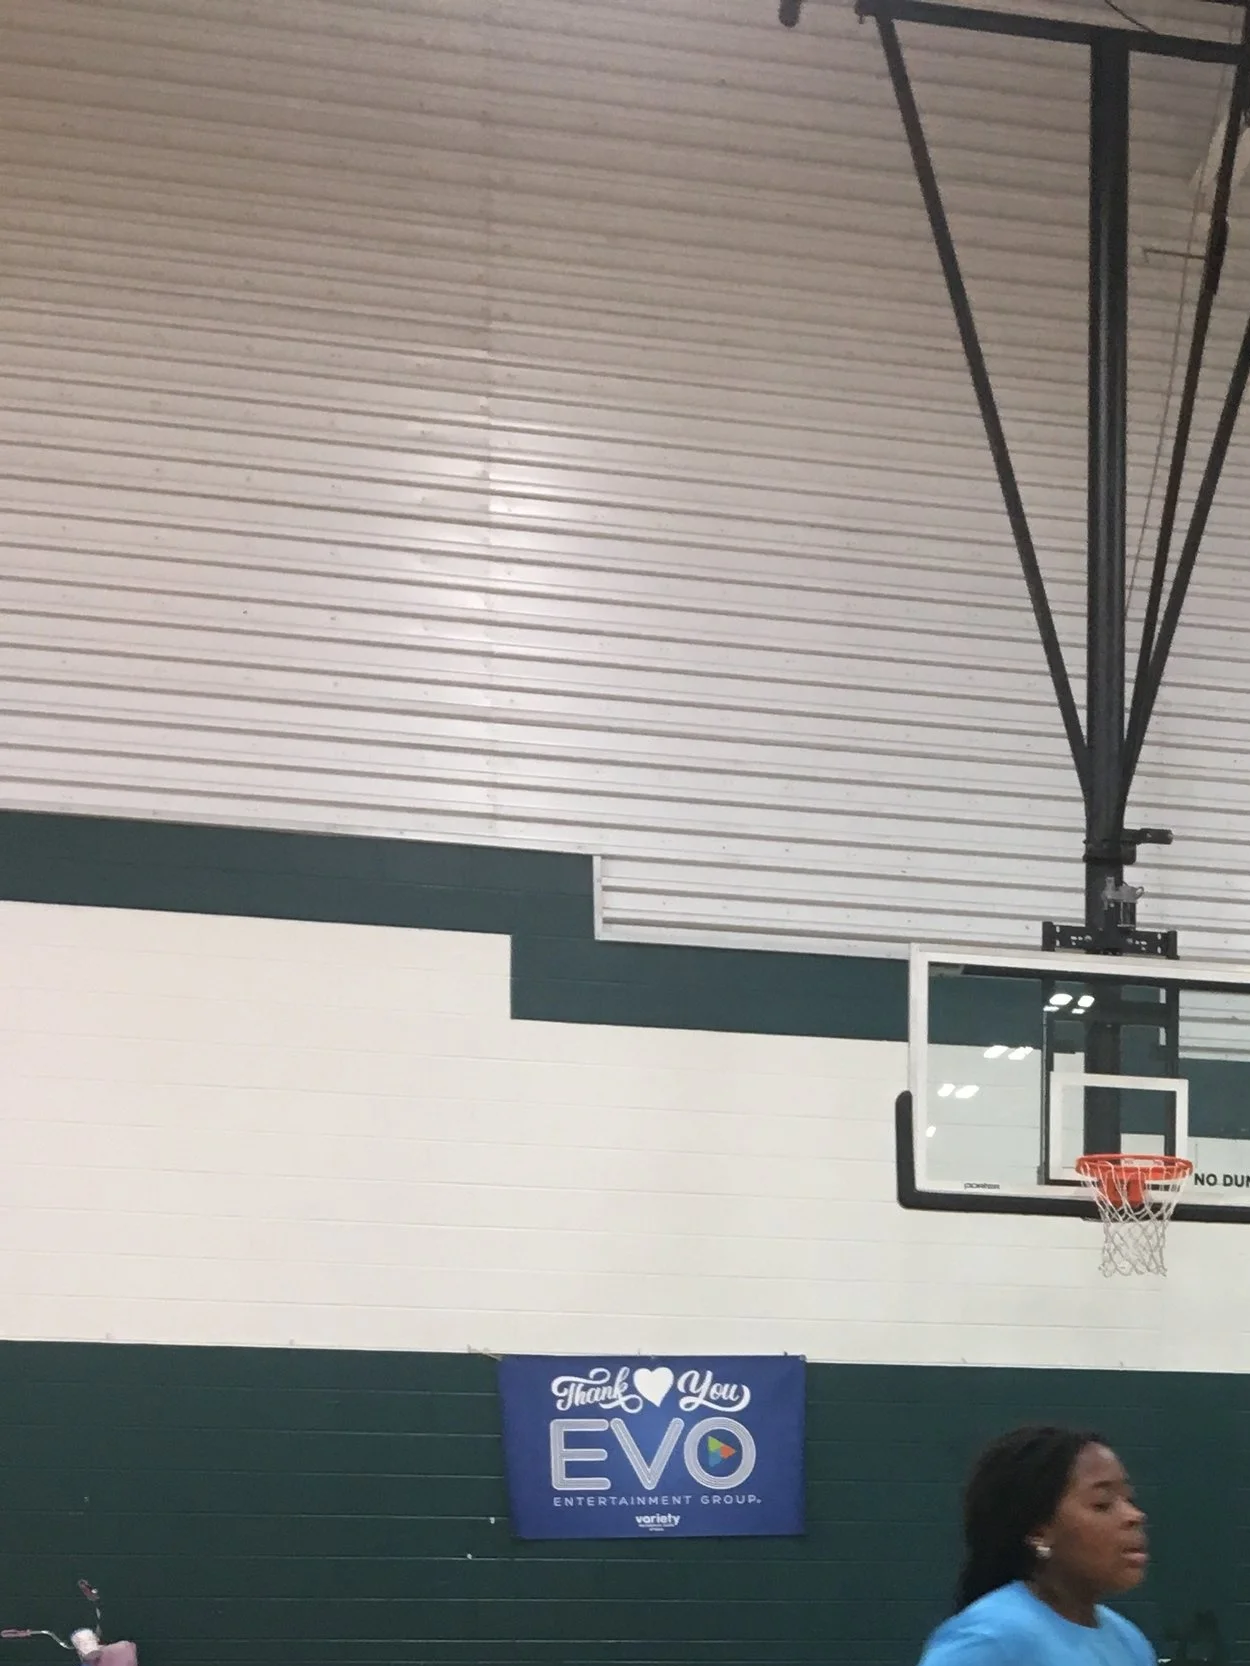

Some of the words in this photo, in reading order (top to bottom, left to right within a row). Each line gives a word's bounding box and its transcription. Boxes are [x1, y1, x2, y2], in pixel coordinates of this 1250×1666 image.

[1194, 1173, 1217, 1187] NO
[551, 1366, 643, 1413] Thank
[678, 1369, 750, 1412] You
[550, 1417, 756, 1490] EVO
[553, 1496, 692, 1507] ENTERTAINMENT
[635, 1513, 680, 1526] variety
